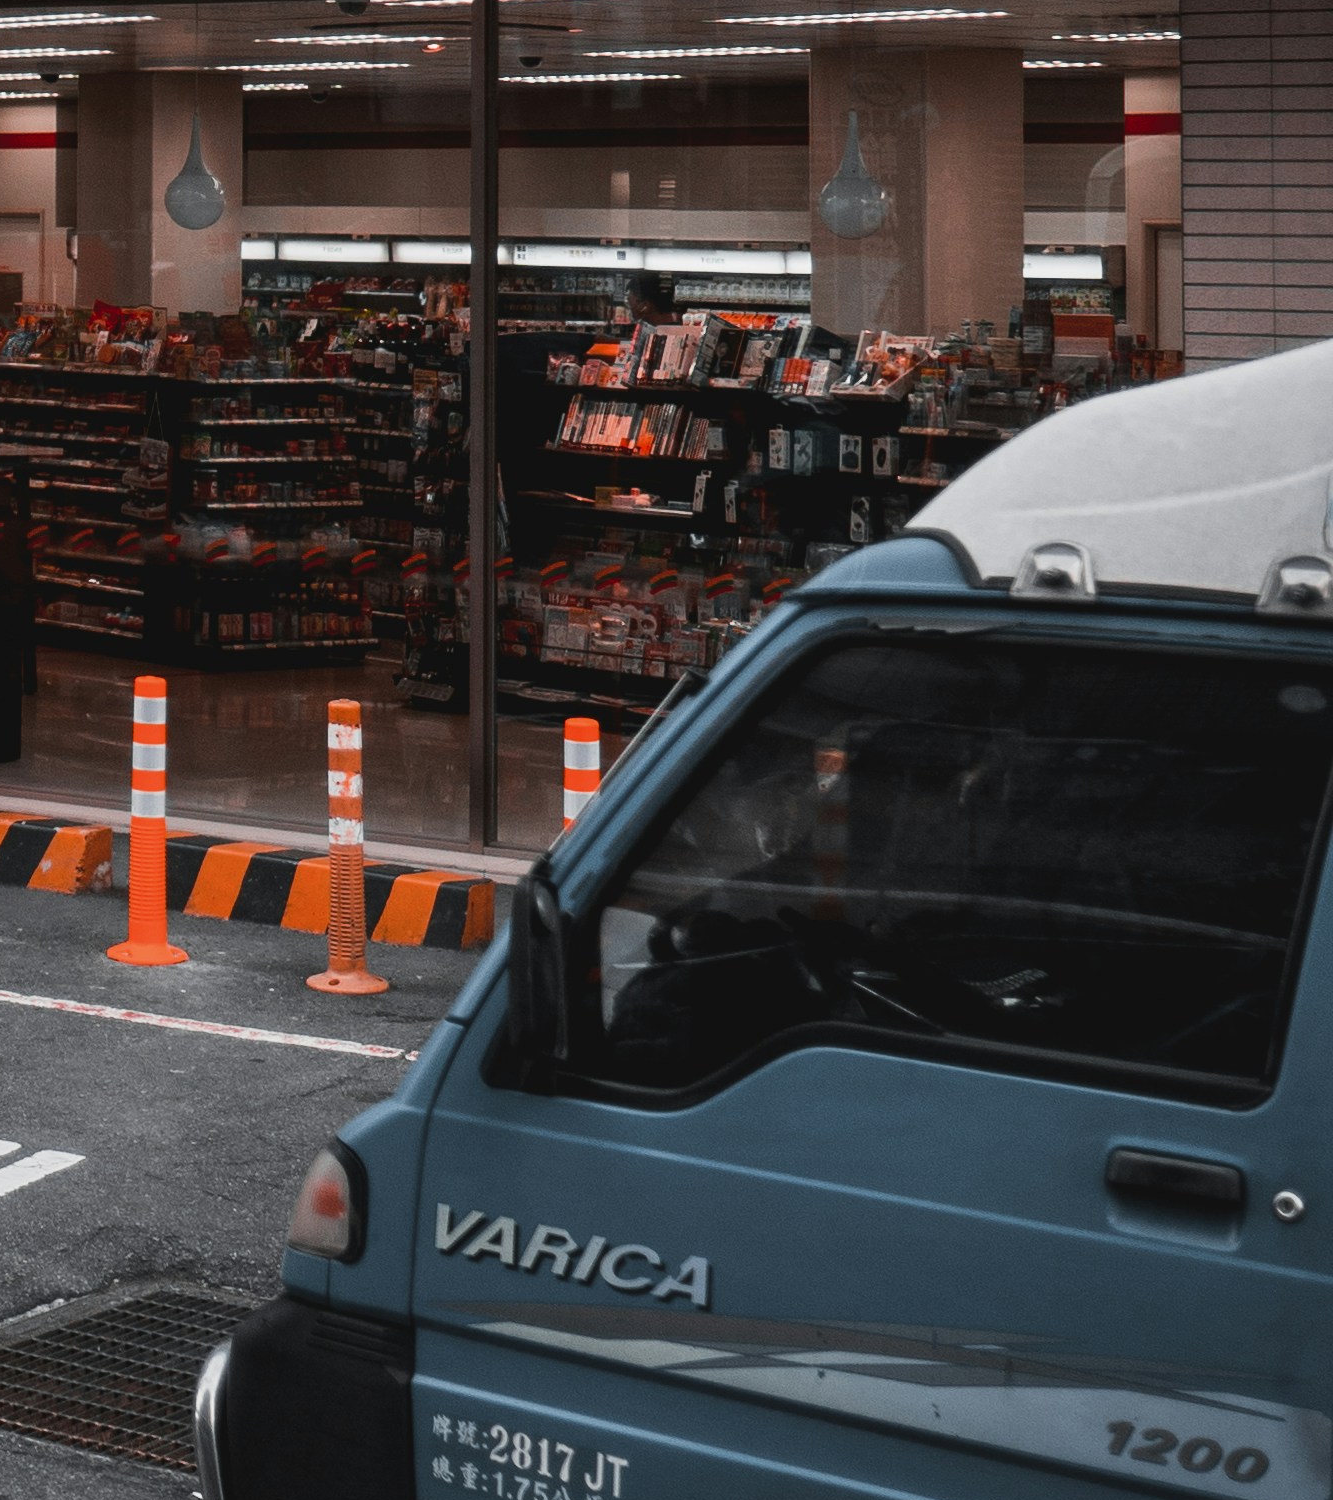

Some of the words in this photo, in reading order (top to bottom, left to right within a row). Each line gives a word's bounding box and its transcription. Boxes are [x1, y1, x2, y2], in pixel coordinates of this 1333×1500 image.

[435, 1203, 712, 1306] VARICA
[584, 1453, 630, 1499] JT
[1106, 1420, 1270, 1484] 1200
